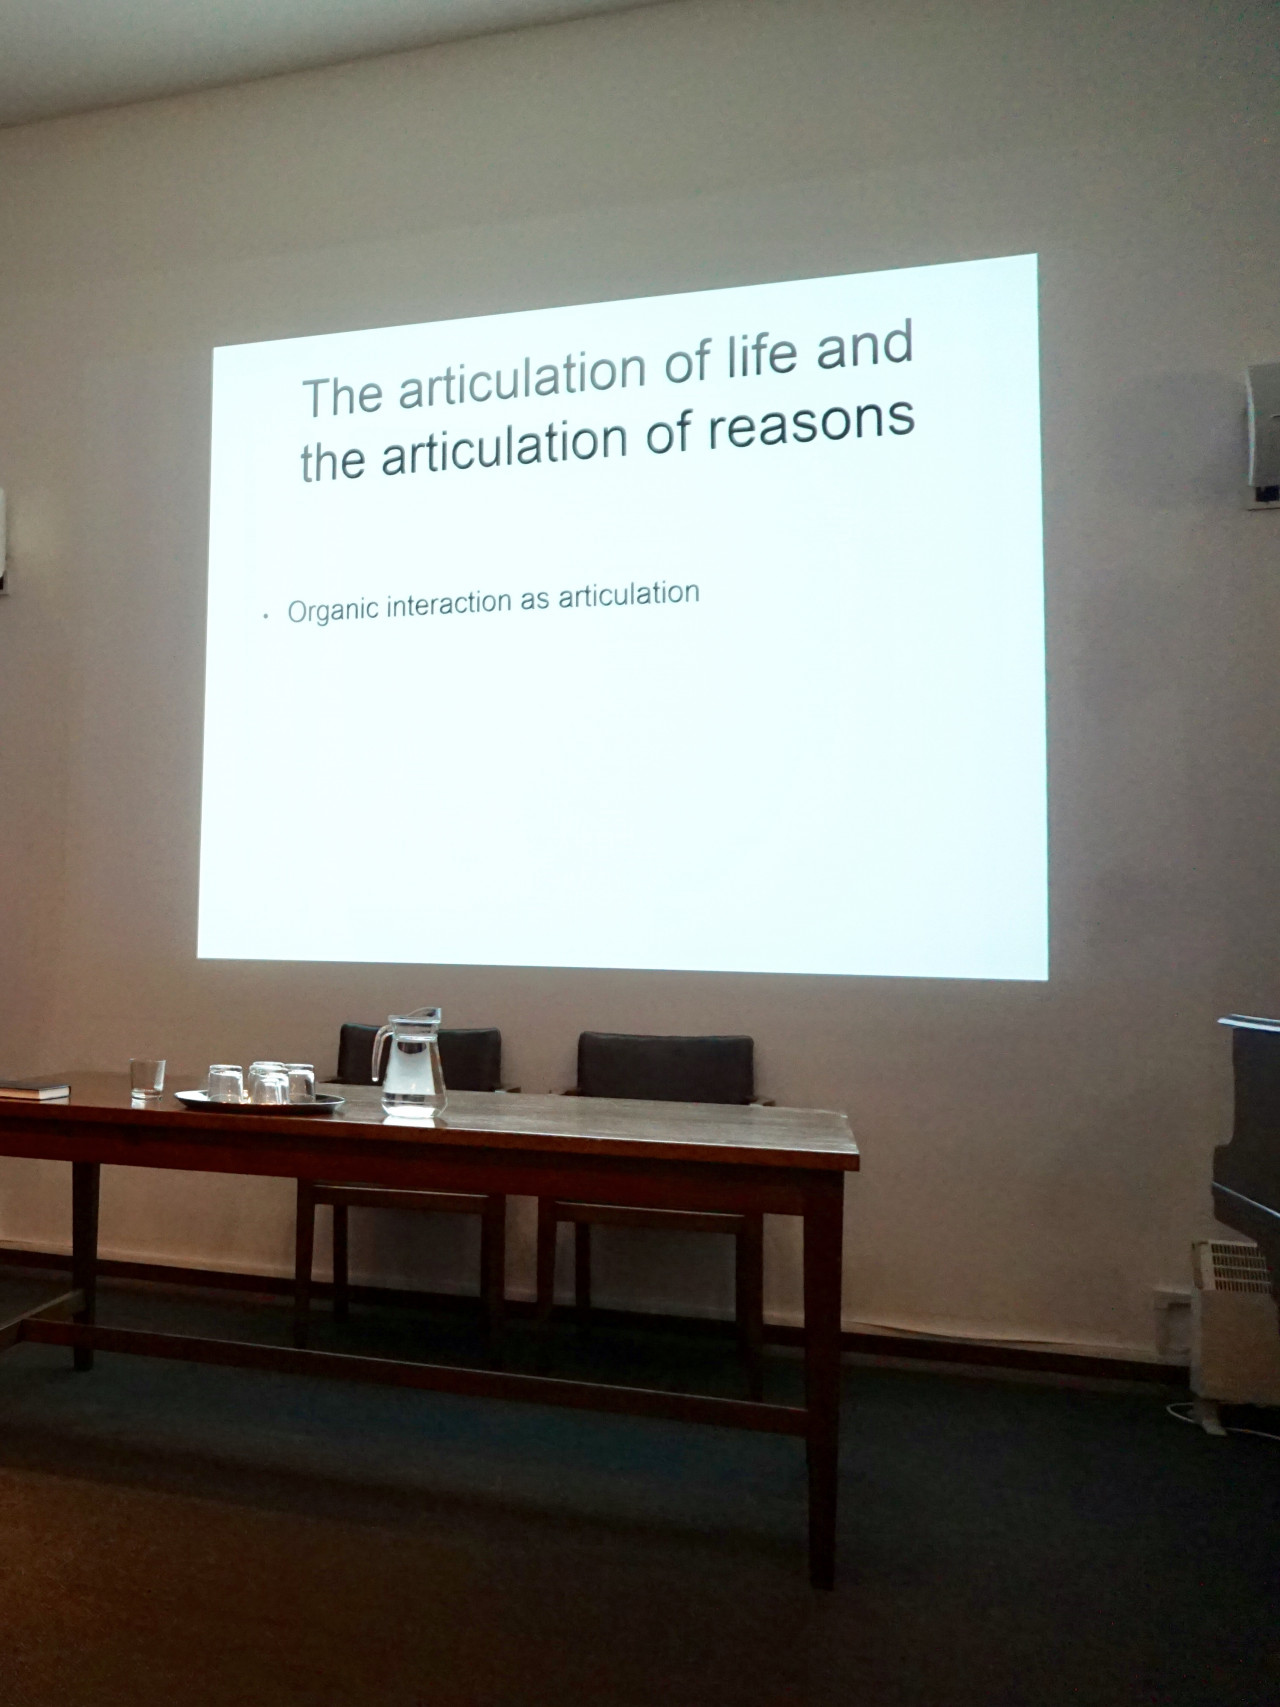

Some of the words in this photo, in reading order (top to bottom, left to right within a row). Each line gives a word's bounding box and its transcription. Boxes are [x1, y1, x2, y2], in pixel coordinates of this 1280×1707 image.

[302, 377, 383, 418] The
[400, 351, 646, 410] articulation
[666, 338, 712, 384] of
[729, 332, 798, 379] life
[818, 318, 913, 370] and
[301, 442, 366, 483] the
[382, 420, 627, 477] articulation
[647, 408, 694, 455] of
[710, 400, 916, 450] reasons
[288, 597, 379, 627] Organic
[387, 590, 512, 618] interaction
[521, 589, 550, 611] as
[559, 580, 700, 609] articulation
